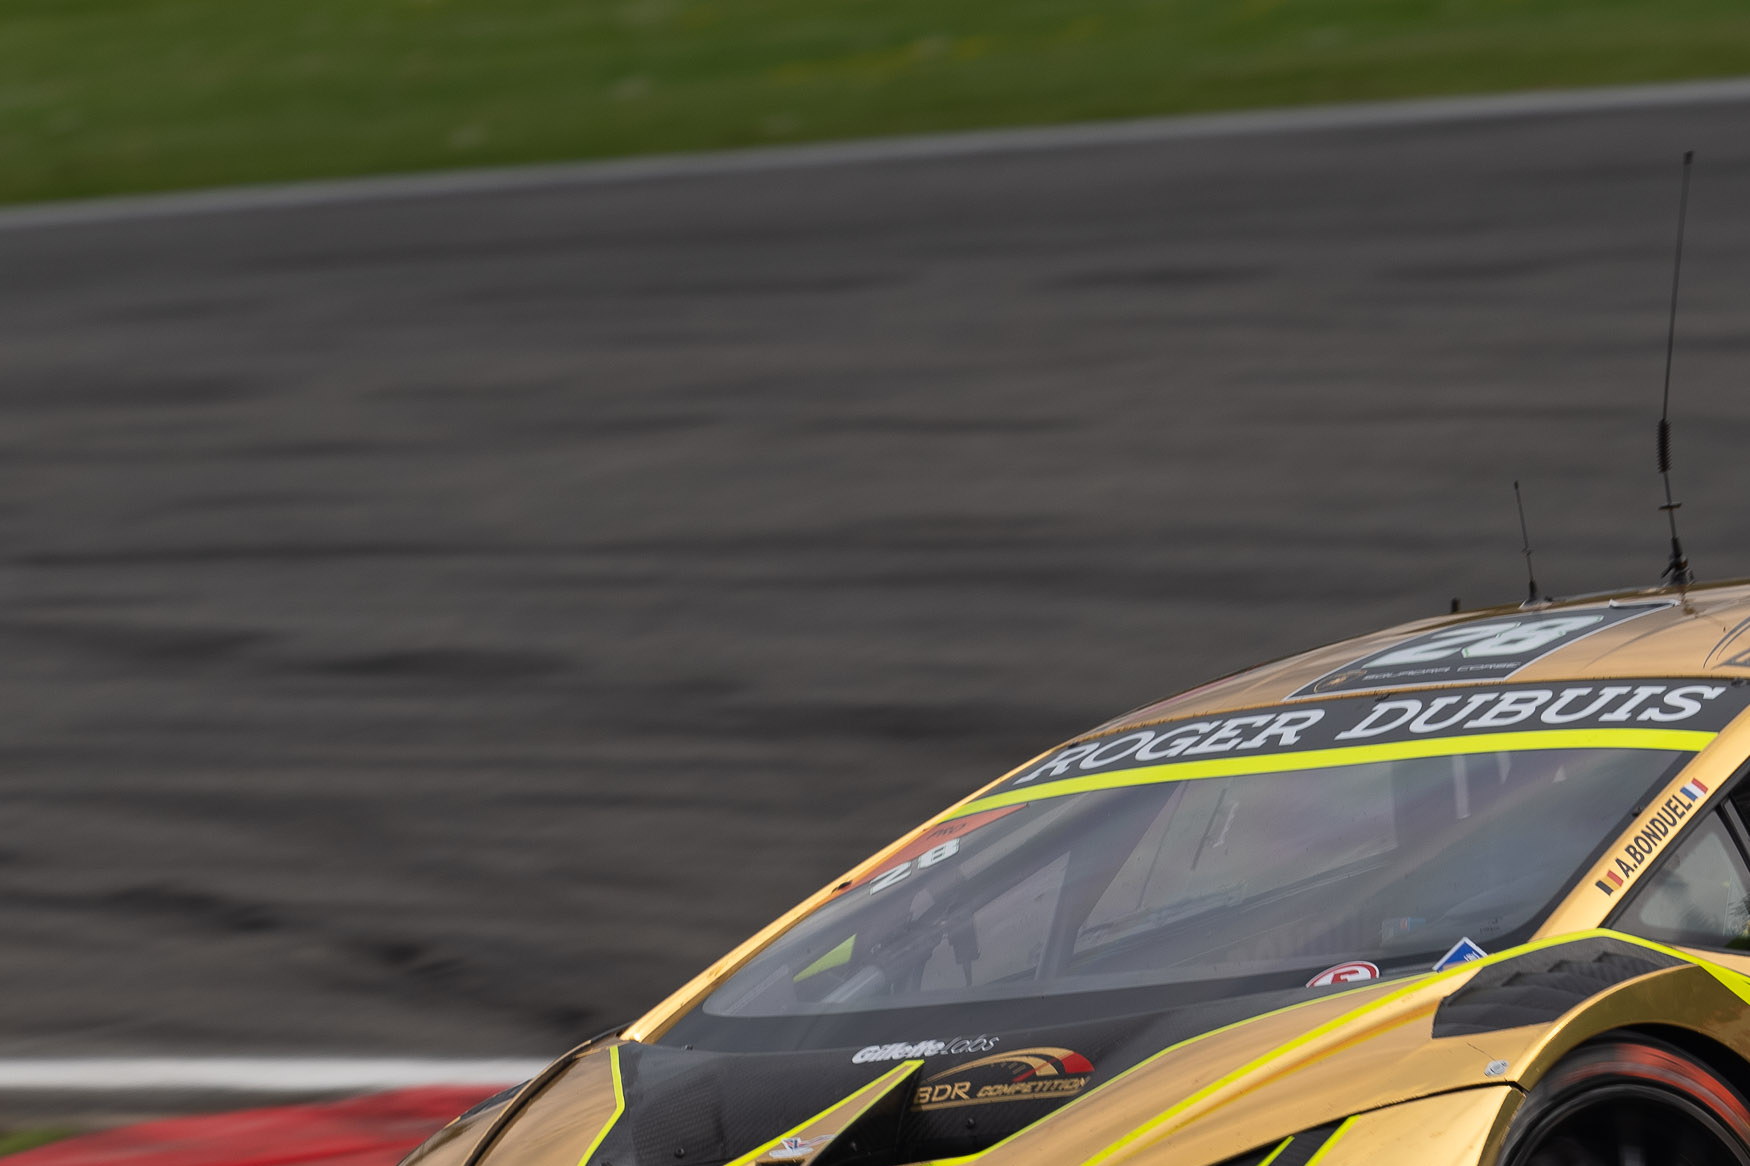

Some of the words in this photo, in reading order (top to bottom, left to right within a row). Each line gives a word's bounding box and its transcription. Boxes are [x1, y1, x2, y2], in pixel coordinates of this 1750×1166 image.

[1361, 615, 1604, 668] 28
[1013, 708, 1325, 786] ROGER
[1334, 685, 1726, 741] DUBUIS
[1614, 794, 1692, 879] A.BONDUEL
[869, 837, 961, 897] 28
[914, 1080, 971, 1105] BDR
